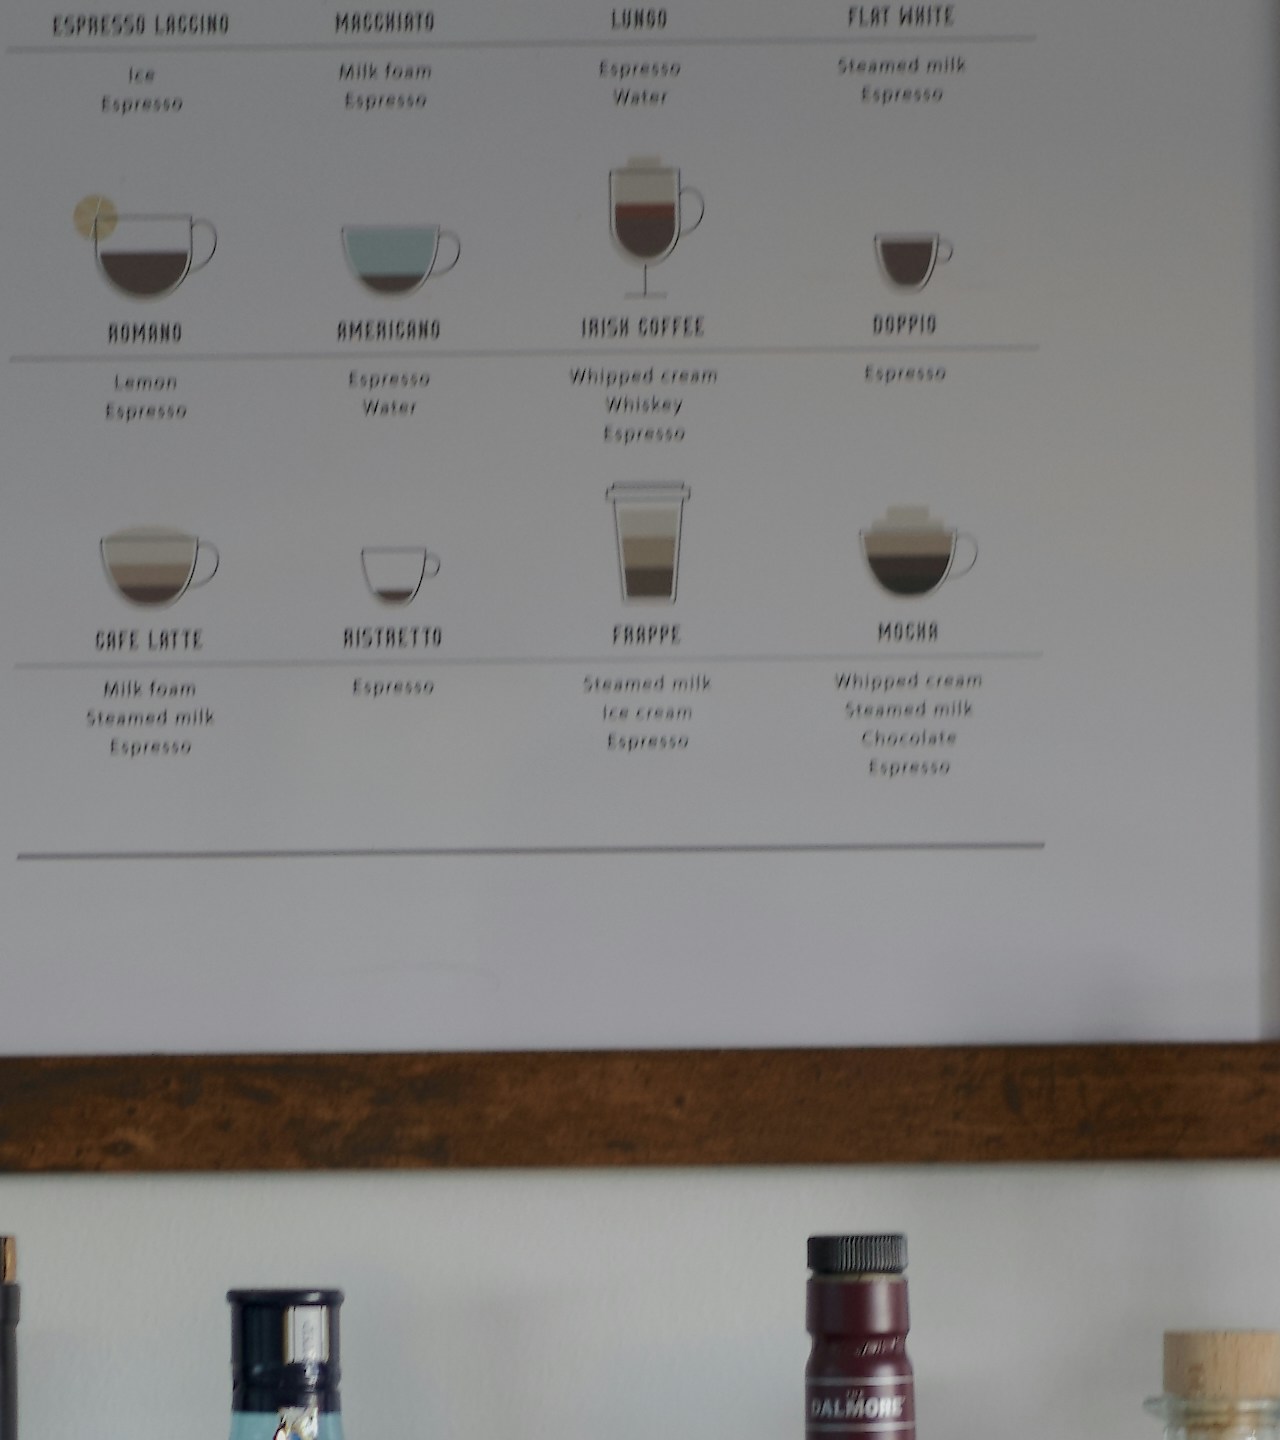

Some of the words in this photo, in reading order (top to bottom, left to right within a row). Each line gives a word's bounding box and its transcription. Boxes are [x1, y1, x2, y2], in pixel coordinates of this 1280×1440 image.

[52, 14, 146, 36] ESPRESSO
[154, 13, 230, 35] LACCINO
[335, 11, 435, 33] MACCHIATO
[611, 8, 668, 30] LUNGO
[847, 5, 890, 27] FLAT
[898, 4, 954, 26] WHITE
[128, 67, 156, 83] Ice
[338, 62, 378, 80] Milk
[384, 61, 432, 80] foam
[598, 59, 682, 80] Espresso
[837, 57, 920, 75] Steamed
[926, 55, 966, 74] milk
[101, 94, 184, 116] Espresso
[344, 91, 428, 112] Espresso
[613, 88, 667, 106] Water
[861, 85, 944, 106] Espresso
[108, 322, 182, 343] ROMANO
[336, 319, 441, 341] AMERICANO
[581, 317, 630, 338] IRISH
[638, 316, 704, 337] COFFEE
[872, 314, 937, 335] DOPPIO
[114, 373, 178, 391] Lemon
[348, 370, 431, 391] Espresso
[569, 367, 654, 388] Whipped
[660, 369, 718, 384] cream
[864, 364, 947, 385] Espresso
[105, 402, 188, 423] Espresso
[362, 399, 417, 416] Water
[605, 395, 683, 416] Whiskey
[603, 424, 686, 446] Espresso
[95, 630, 136, 651] CAFE
[148, 629, 201, 650] LATTE
[343, 626, 443, 648] RISTRETTO
[612, 624, 679, 645] FRAPPE
[877, 621, 939, 642] MOCHA
[103, 680, 142, 697] Milk
[149, 680, 197, 697] foam
[352, 678, 435, 699] Espresso
[583, 675, 665, 693] Steamed
[672, 674, 711, 691] milk
[834, 672, 919, 693] Whipped
[925, 674, 983, 689] cream
[86, 709, 168, 727] Steamed
[175, 707, 214, 726] milk
[602, 705, 629, 720] Ice
[635, 707, 693, 721] cream
[844, 701, 927, 719] Steamed
[933, 699, 973, 717] milk
[109, 737, 192, 759] Espresso
[607, 732, 689, 753] Espresso
[861, 729, 957, 747] Chocolate
[868, 758, 951, 779] Espresso
[812, 1396, 903, 1418] DALMORE
